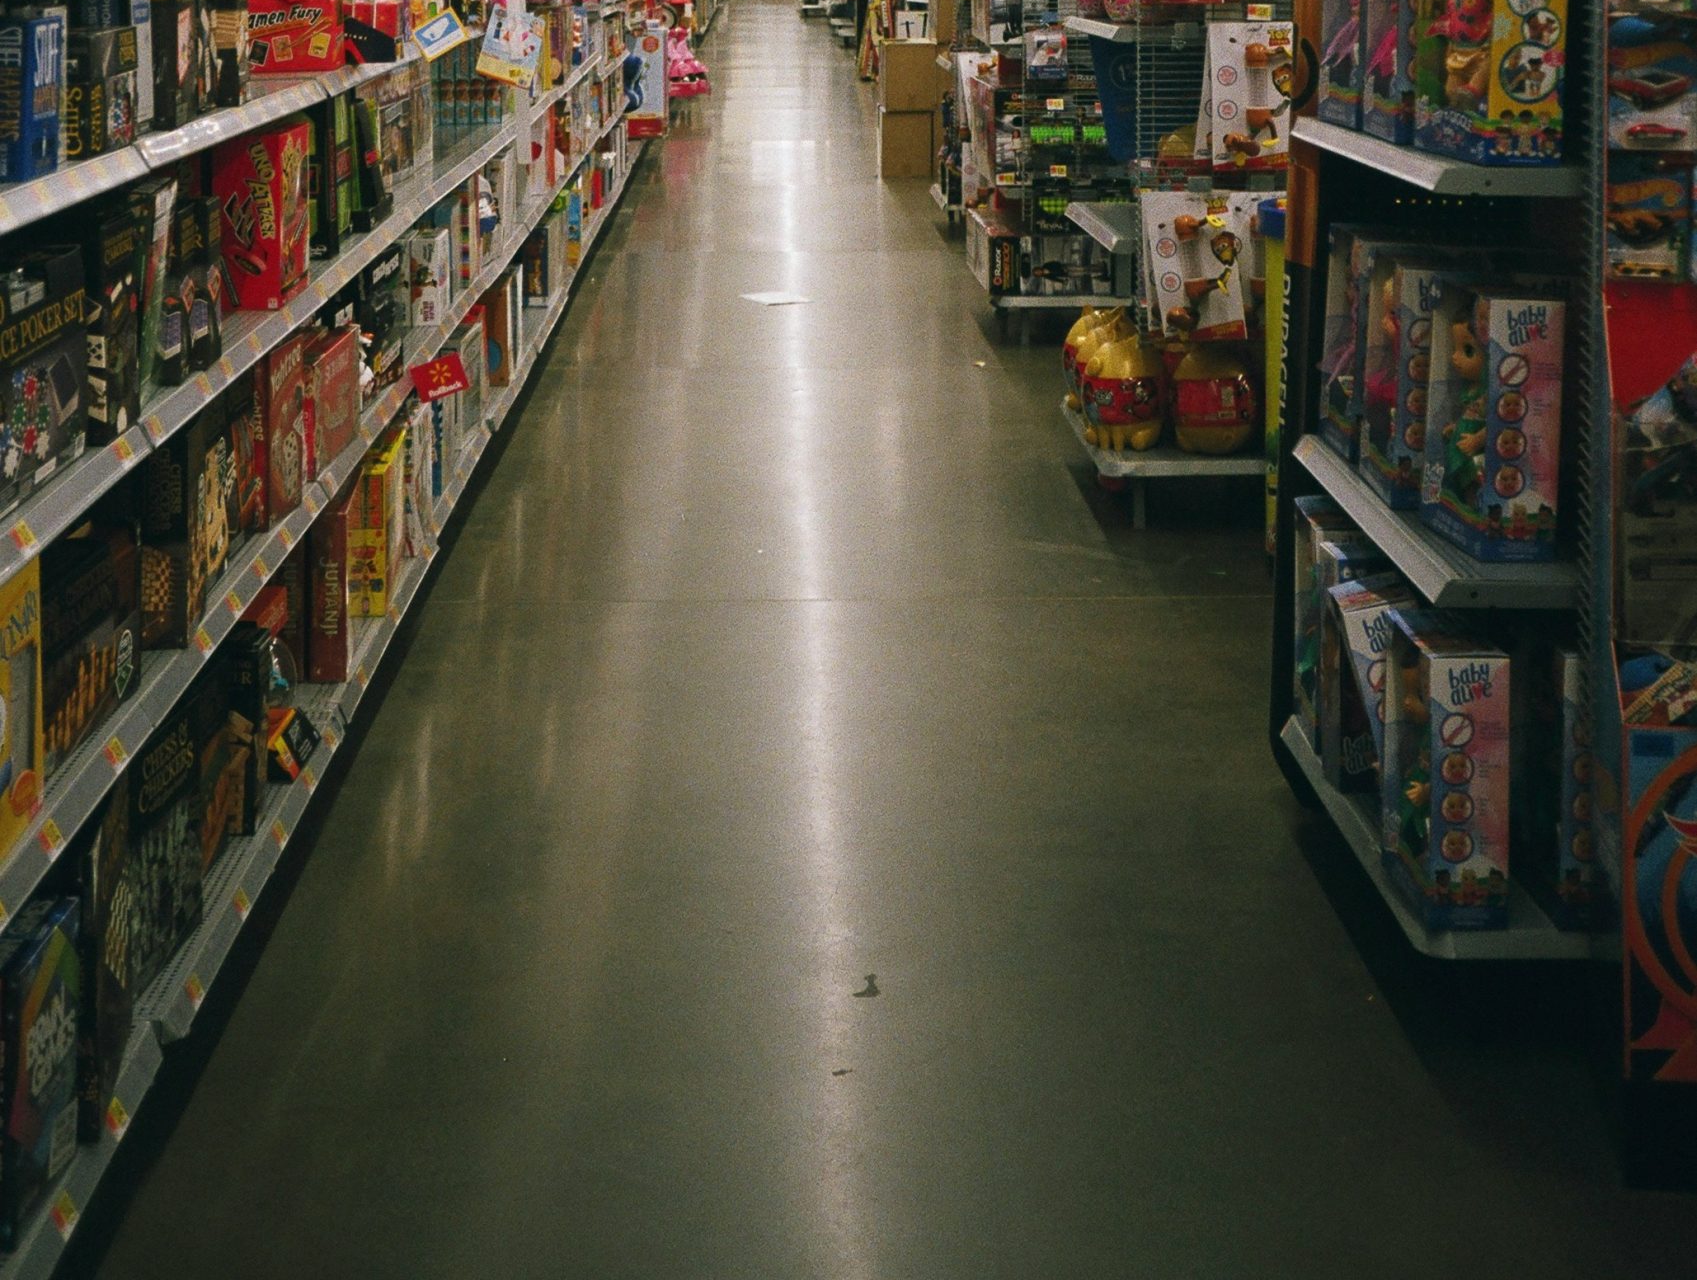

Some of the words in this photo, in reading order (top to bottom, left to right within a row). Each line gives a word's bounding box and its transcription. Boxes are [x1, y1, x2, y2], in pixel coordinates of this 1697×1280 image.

[248, 10, 286, 29] amen
[288, 3, 323, 26] Fury
[0, 67, 21, 143] HAPPENS
[66, 85, 84, 157] CHIPS
[248, 139, 275, 184] UNO
[246, 177, 276, 241] ATTACK
[993, 246, 1002, 277] Razor
[20, 300, 64, 350] POKER
[63, 286, 87, 325] SET
[1506, 304, 1547, 330] baby
[1507, 323, 1549, 348] alive
[427, 380, 464, 399] Rollback
[319, 556, 342, 639] JUMANJI
[1447, 662, 1491, 692] baby
[1450, 678, 1493, 707] alive
